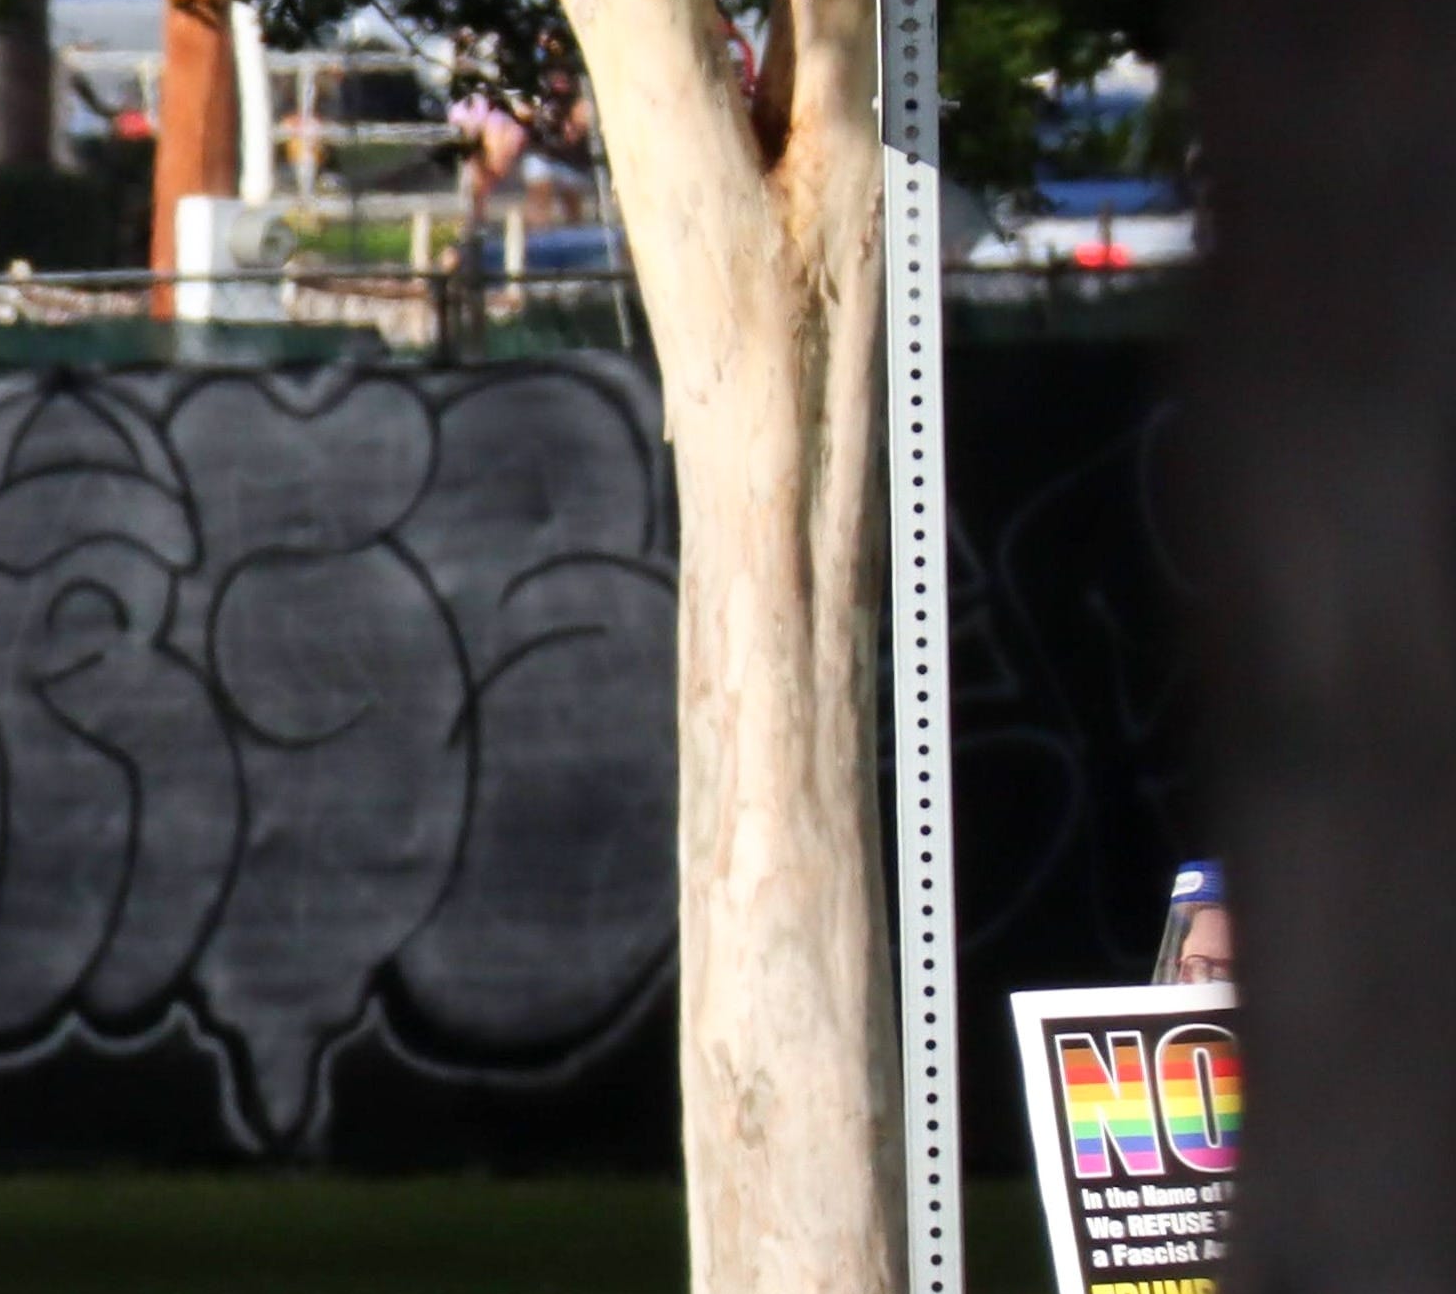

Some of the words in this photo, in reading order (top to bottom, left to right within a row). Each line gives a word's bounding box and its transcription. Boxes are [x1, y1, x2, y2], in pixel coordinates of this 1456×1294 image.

[1081, 1187, 1103, 1210] In
[1105, 1186, 1139, 1208] the
[1141, 1184, 1197, 1206] Name
[1086, 1216, 1124, 1240] We
[1127, 1211, 1215, 1238] REFUSE
[1092, 1249, 1110, 1268] a
[1111, 1241, 1198, 1267] Fascist
